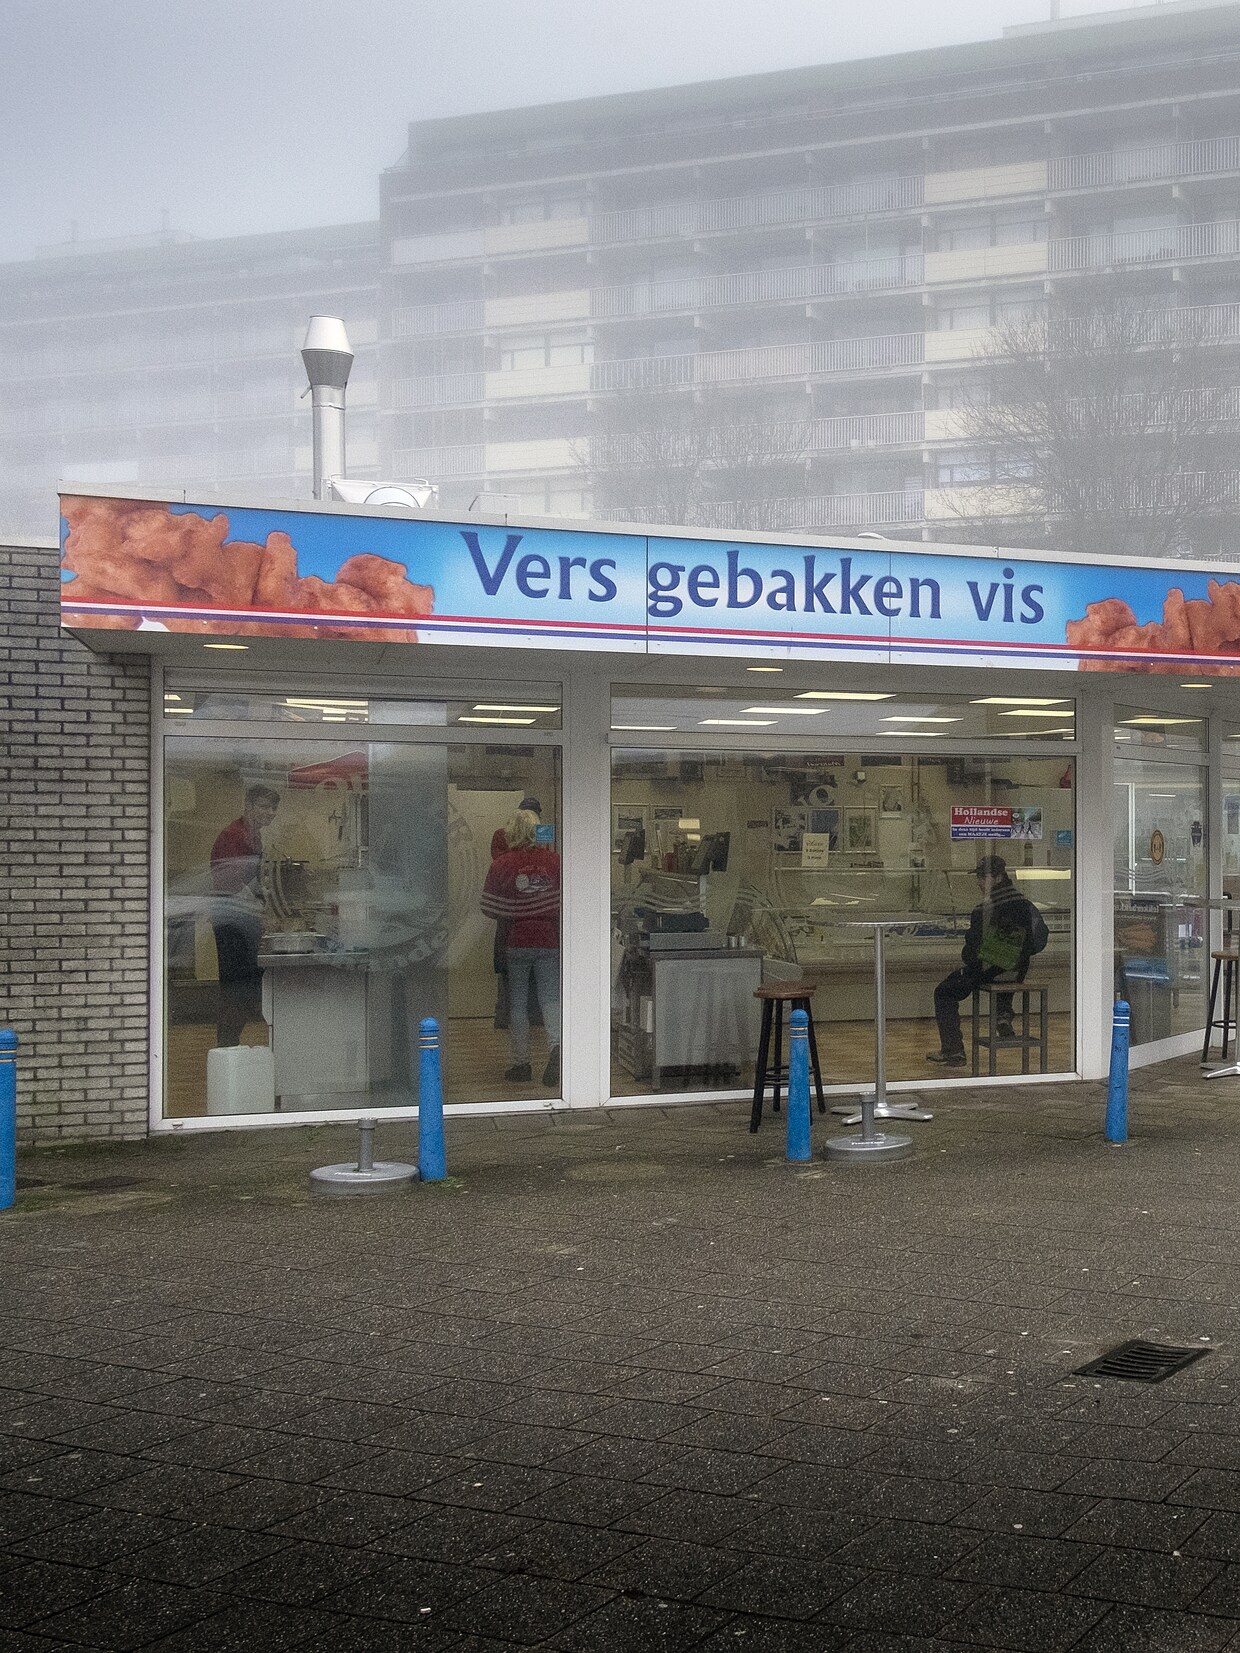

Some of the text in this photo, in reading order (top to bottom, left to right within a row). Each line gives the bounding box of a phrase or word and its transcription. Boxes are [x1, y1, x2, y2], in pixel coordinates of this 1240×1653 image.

[460, 530, 1045, 625] Vers gebakken vis
[954, 807, 1008, 817] Hollandse
[964, 816, 999, 825] Nieuwe
